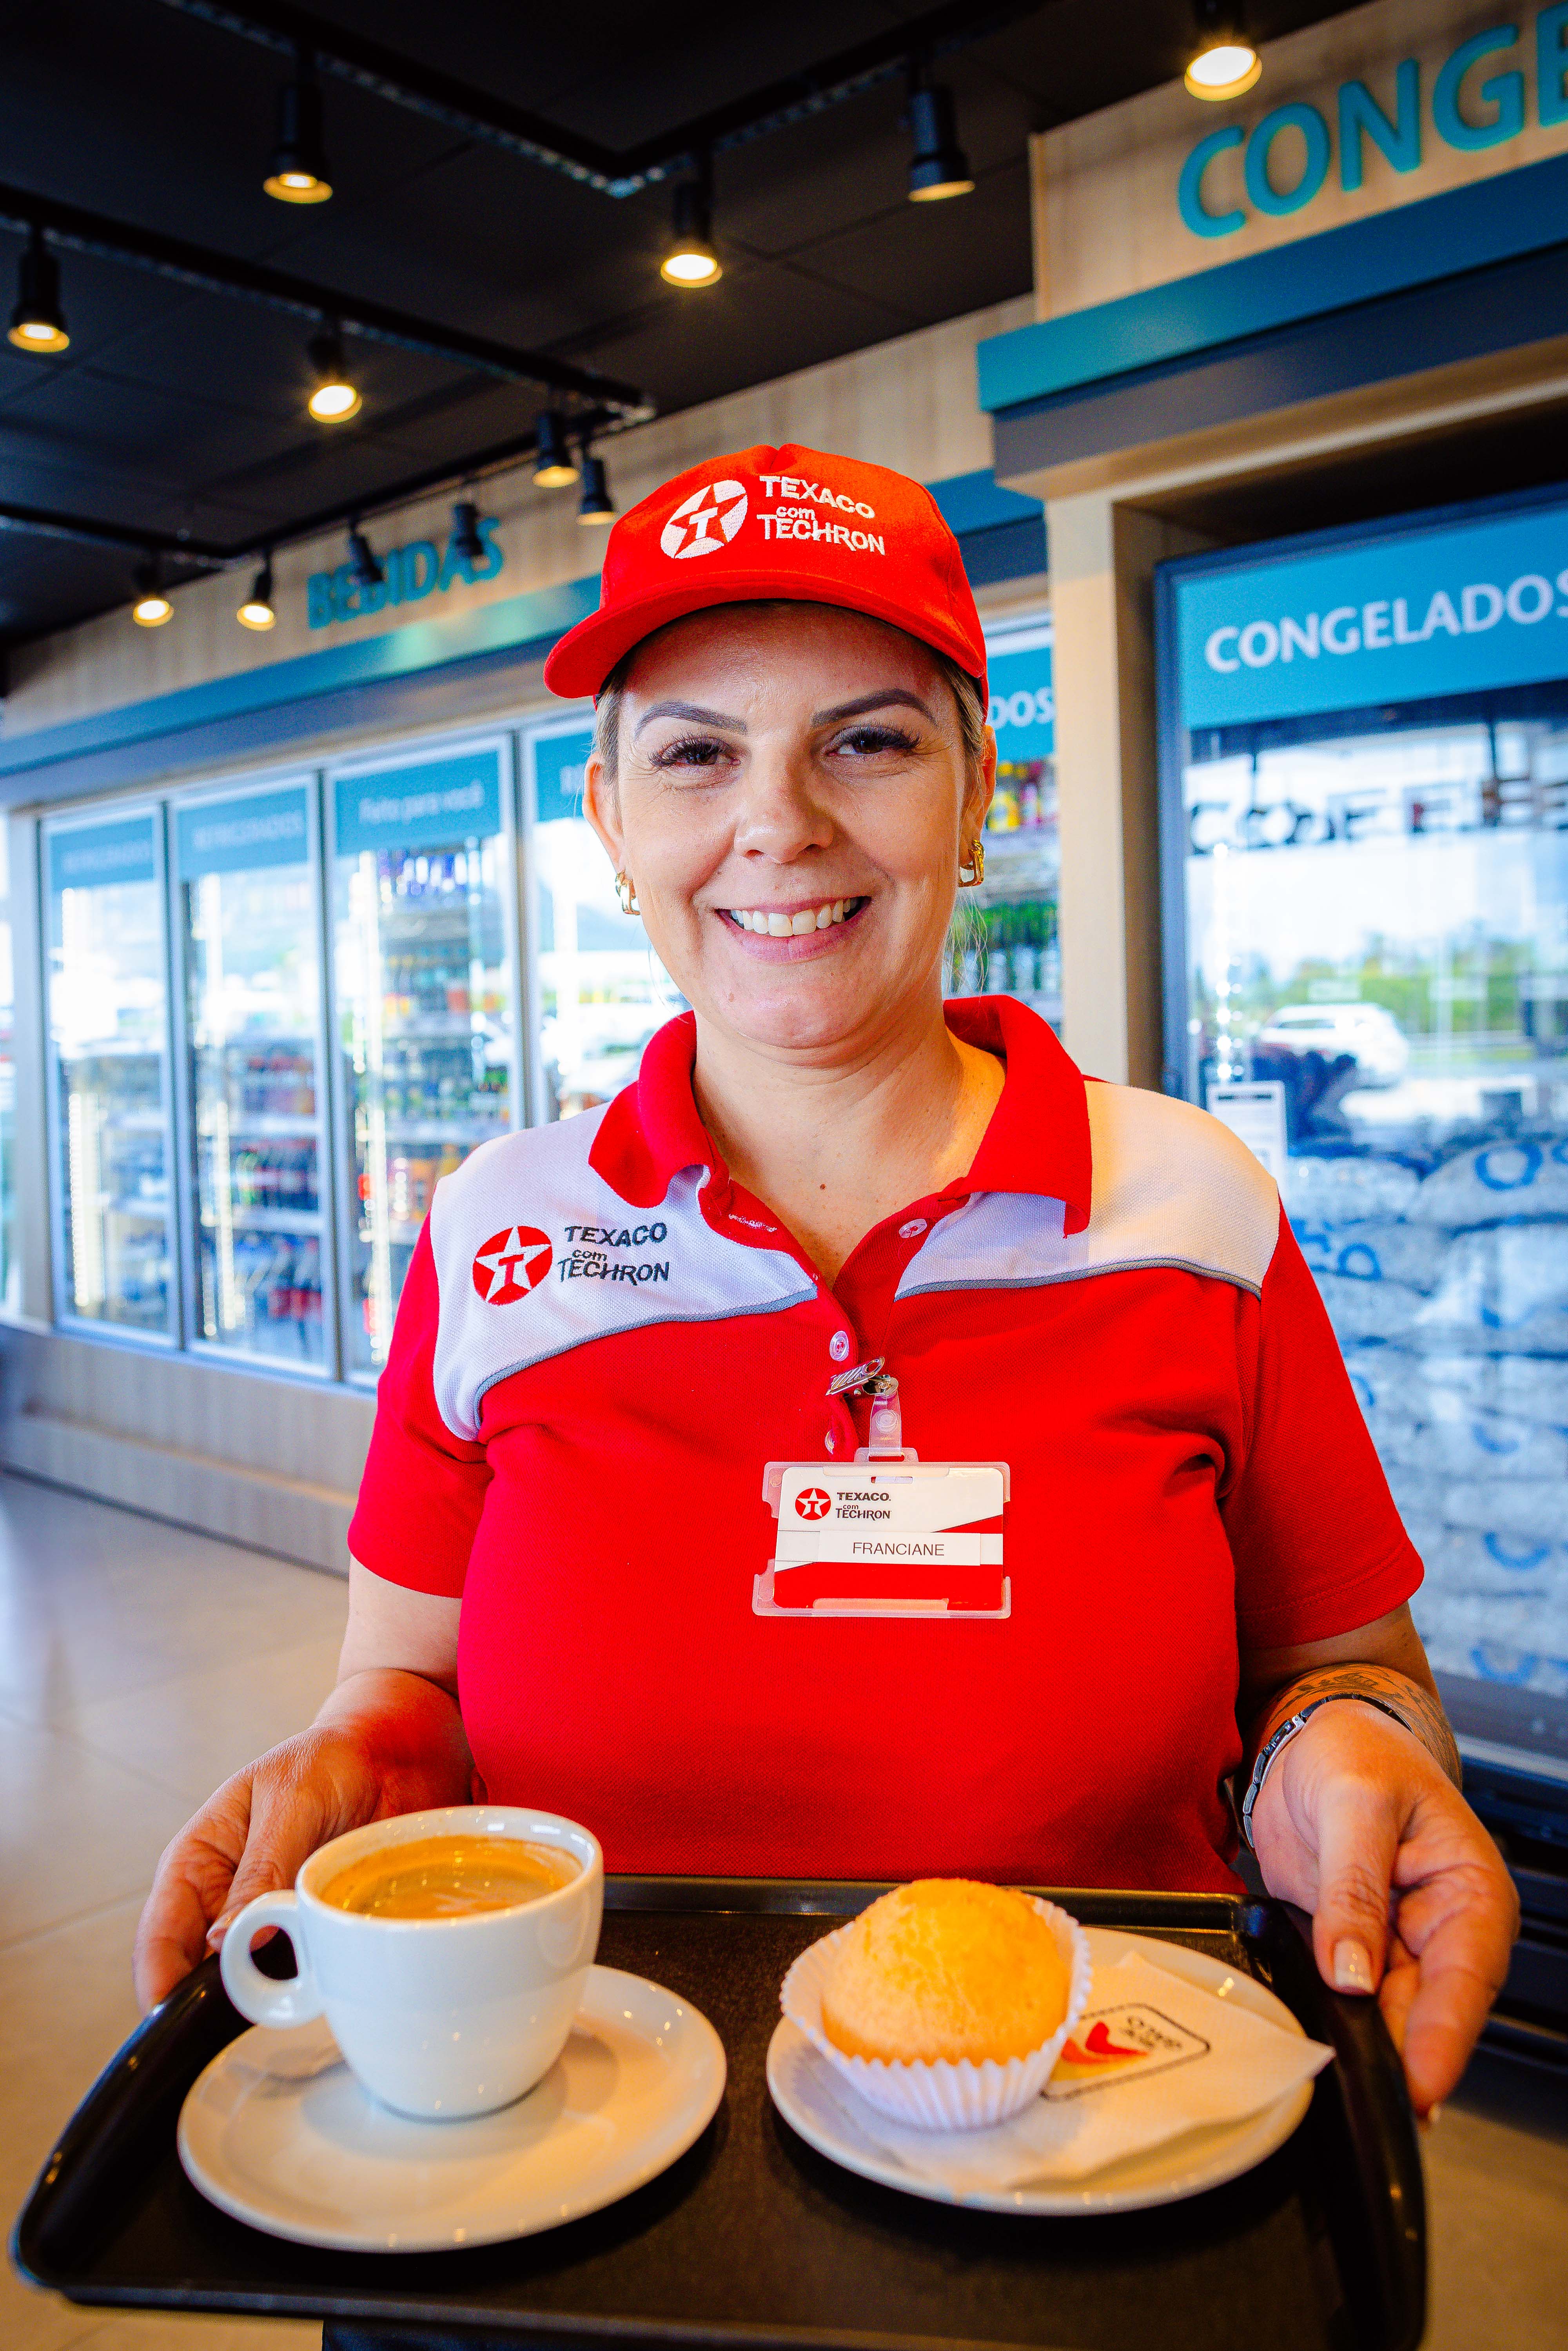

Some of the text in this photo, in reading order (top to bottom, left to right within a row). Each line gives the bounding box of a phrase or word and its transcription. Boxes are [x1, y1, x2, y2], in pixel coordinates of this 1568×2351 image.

[759, 476, 875, 519] TEXACO
[776, 506, 816, 521] com
[757, 514, 885, 556] TECHRON
[564, 1222, 667, 1247] TEXACO
[572, 1249, 608, 1260] com
[557, 1257, 670, 1286] TECHRON
[835, 1508, 891, 1521] TECHRON
[852, 1542, 944, 1556] FRANCIANE
